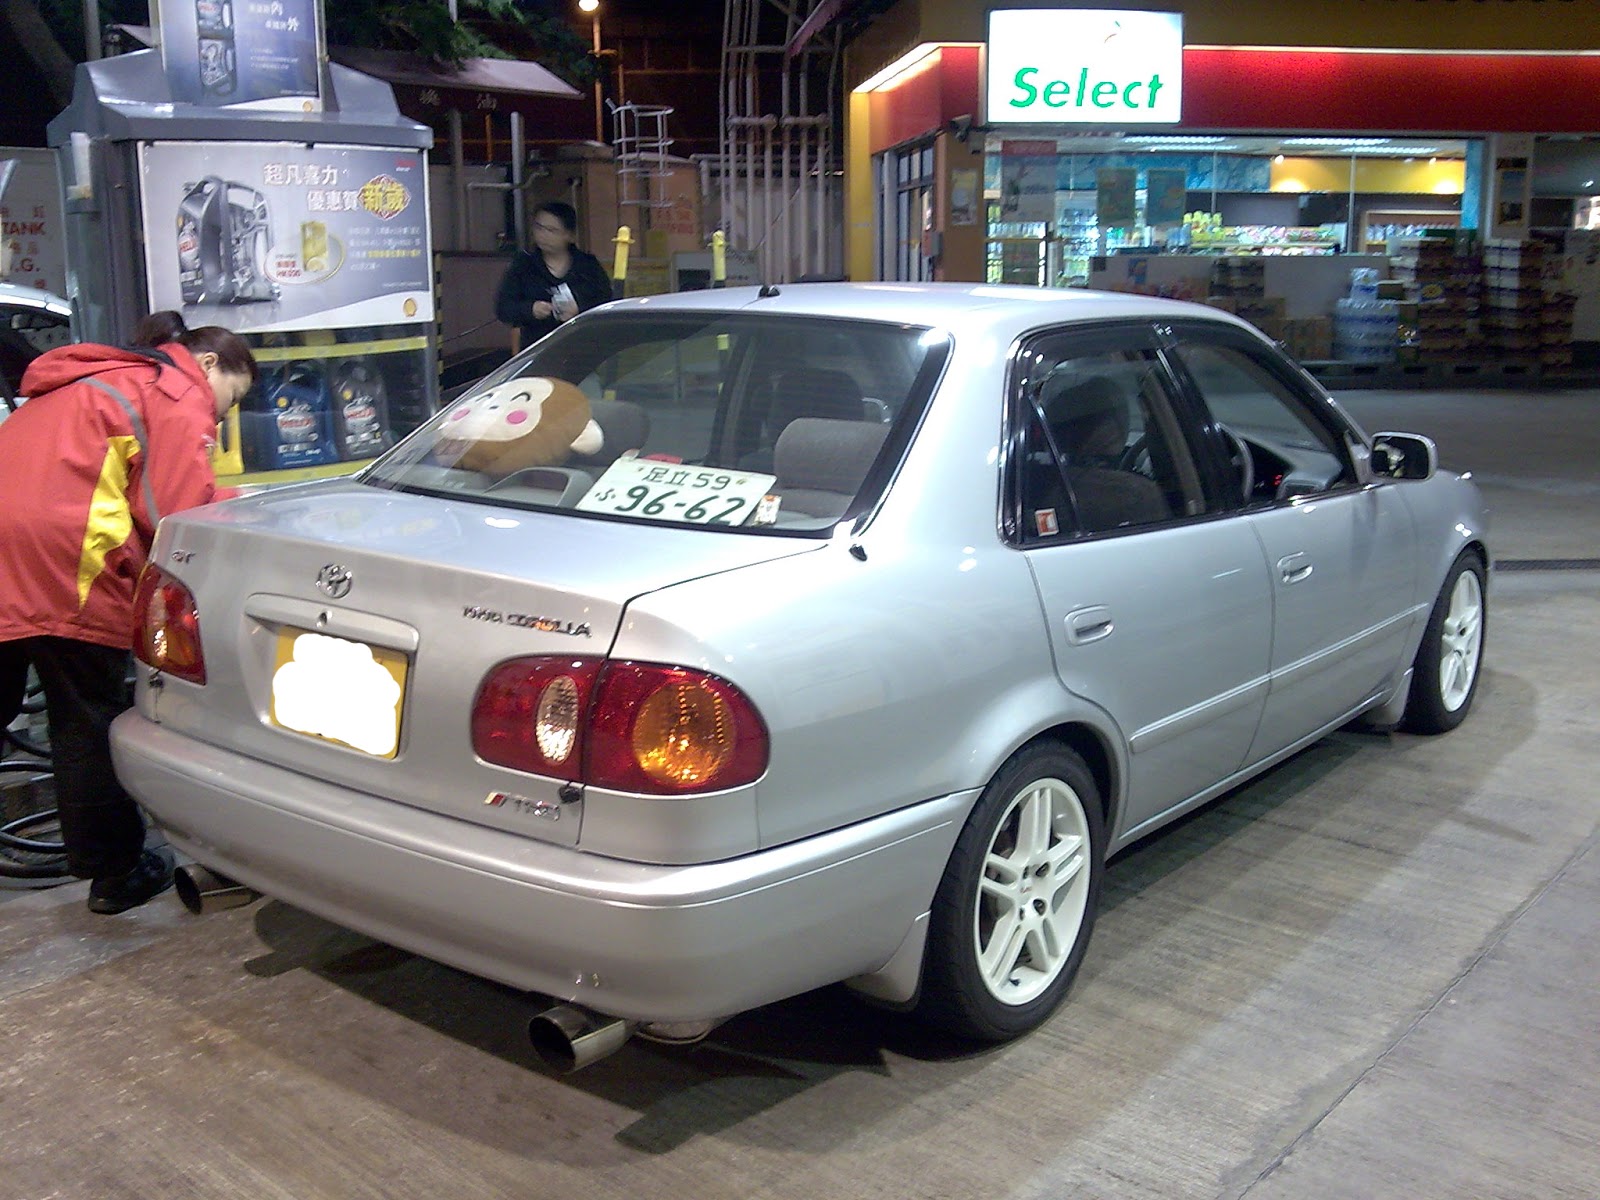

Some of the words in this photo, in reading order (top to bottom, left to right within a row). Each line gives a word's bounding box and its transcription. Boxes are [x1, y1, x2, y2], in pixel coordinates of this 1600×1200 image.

[1009, 67, 1163, 108] Select
[692, 472, 731, 490] 59
[614, 485, 746, 525] 96-62
